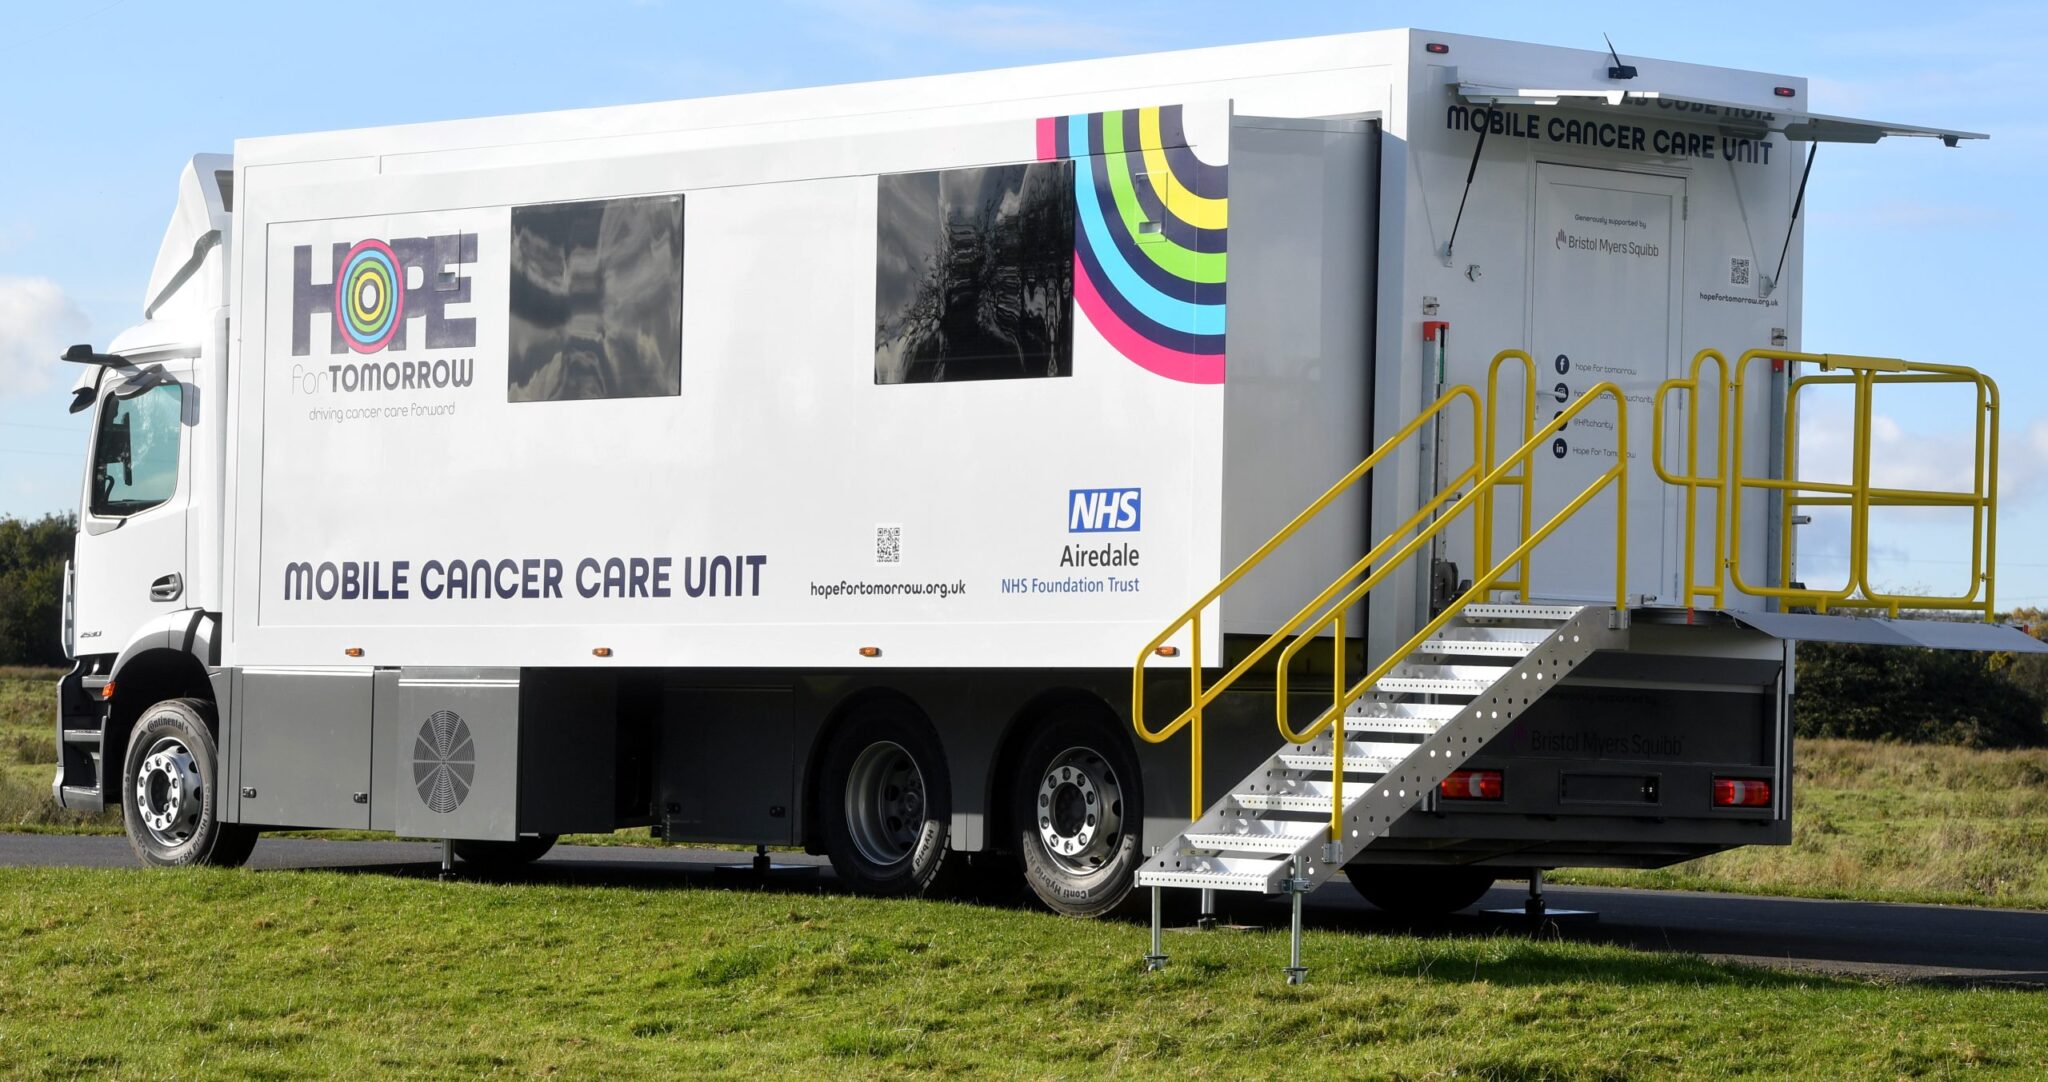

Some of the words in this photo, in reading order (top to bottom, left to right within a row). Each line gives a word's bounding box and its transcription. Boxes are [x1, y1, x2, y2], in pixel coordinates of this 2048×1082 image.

[1447, 104, 1540, 140] MOBILE
[1547, 117, 1645, 151] CANCER
[1653, 128, 1715, 159] CARE
[1722, 136, 1773, 165] UNIT
[1574, 214, 1608, 225] Generously
[1609, 217, 1639, 228] supported
[1568, 235, 1598, 251] Bristol
[1599, 238, 1628, 255] Myers
[1629, 241, 1659, 257] Squibb
[291, 232, 479, 357] HOPE
[1699, 291, 1779, 307] hopefortomorrow.org.uk
[1575, 362, 1592, 372] hope
[1604, 366, 1638, 376] tomorrow
[309, 406, 344, 424] driving
[345, 407, 382, 420] cancer
[384, 404, 409, 418] care
[410, 401, 456, 417] forward
[1572, 447, 1590, 456] Hope
[1069, 490, 1139, 530] NHS
[1060, 543, 1140, 568] Airedale
[284, 561, 410, 601] MOBILE
[420, 558, 564, 600] CANCER
[575, 557, 673, 599] CARE
[684, 555, 767, 597] UNIT
[810, 579, 966, 599] hopefortomorrow.org.uk
[1001, 577, 1027, 594] NHS
[1031, 576, 1104, 594] Foundation
[1107, 576, 1140, 593] Trust
[147, 715, 185, 733] Continental
[1531, 730, 1580, 751] Bristol
[1583, 732, 1630, 757] Myers
[1631, 734, 1682, 759] Squibb
[914, 829, 935, 868] Hybrid
[1034, 865, 1062, 896] Hybrid
[1063, 888, 1088, 899] Conti
